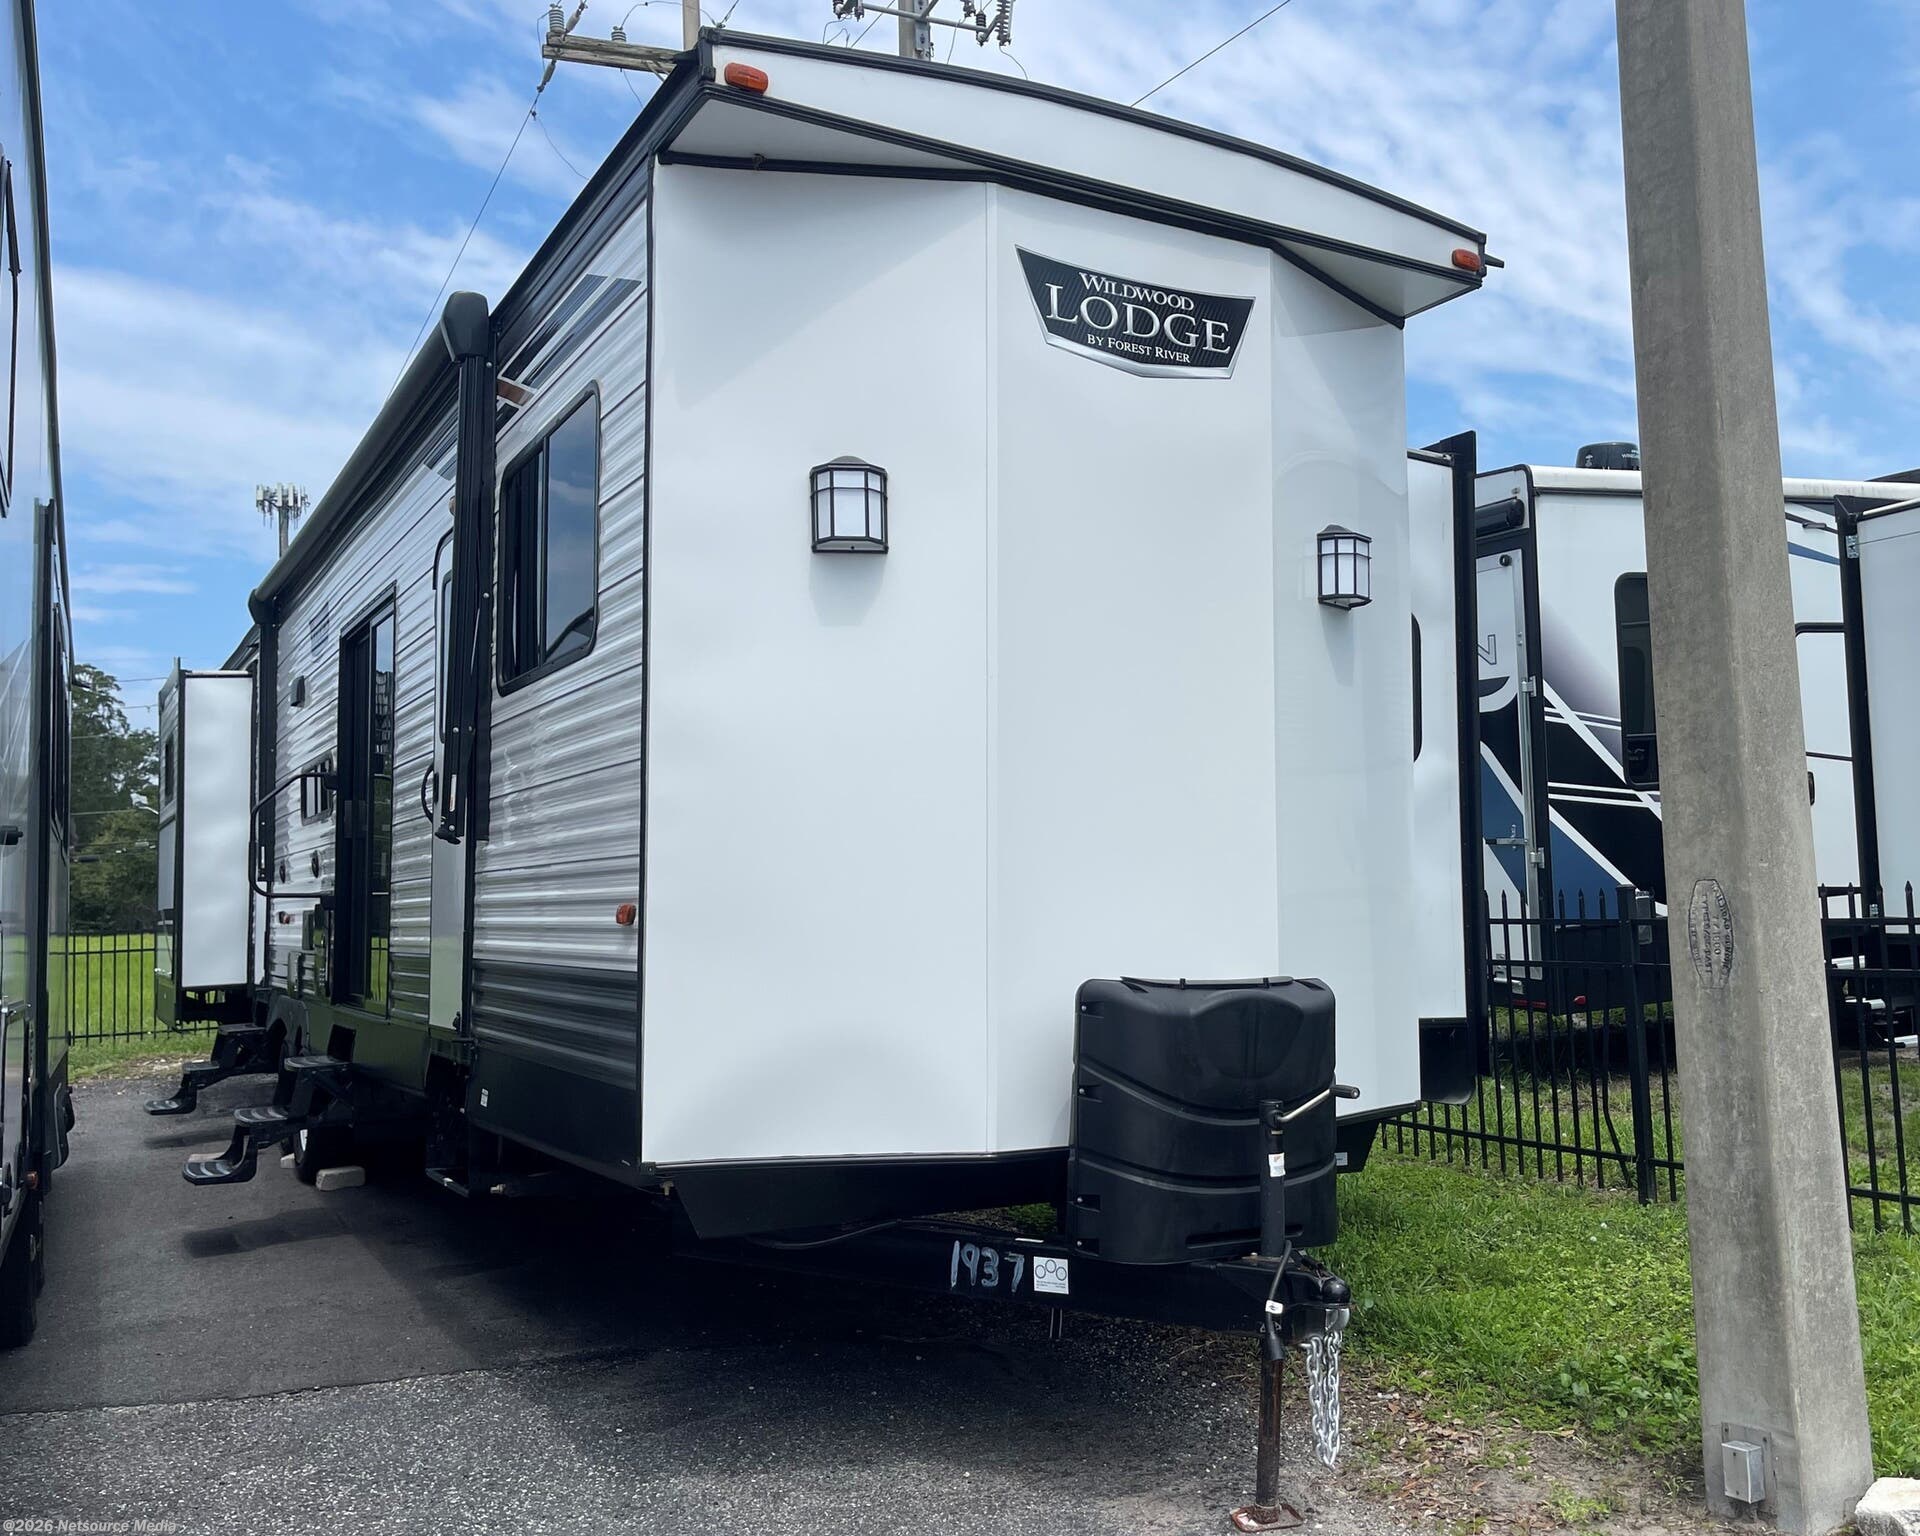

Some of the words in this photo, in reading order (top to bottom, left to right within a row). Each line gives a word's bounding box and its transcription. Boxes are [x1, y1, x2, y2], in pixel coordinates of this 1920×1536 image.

[1079, 272, 1194, 311] WILDWOOD
[1045, 283, 1230, 354] LODGE
[1087, 333, 1104, 347] BY
[1108, 337, 1152, 356] FOREST
[1155, 346, 1191, 363] RIVER
[951, 1240, 1025, 1293] 1937
